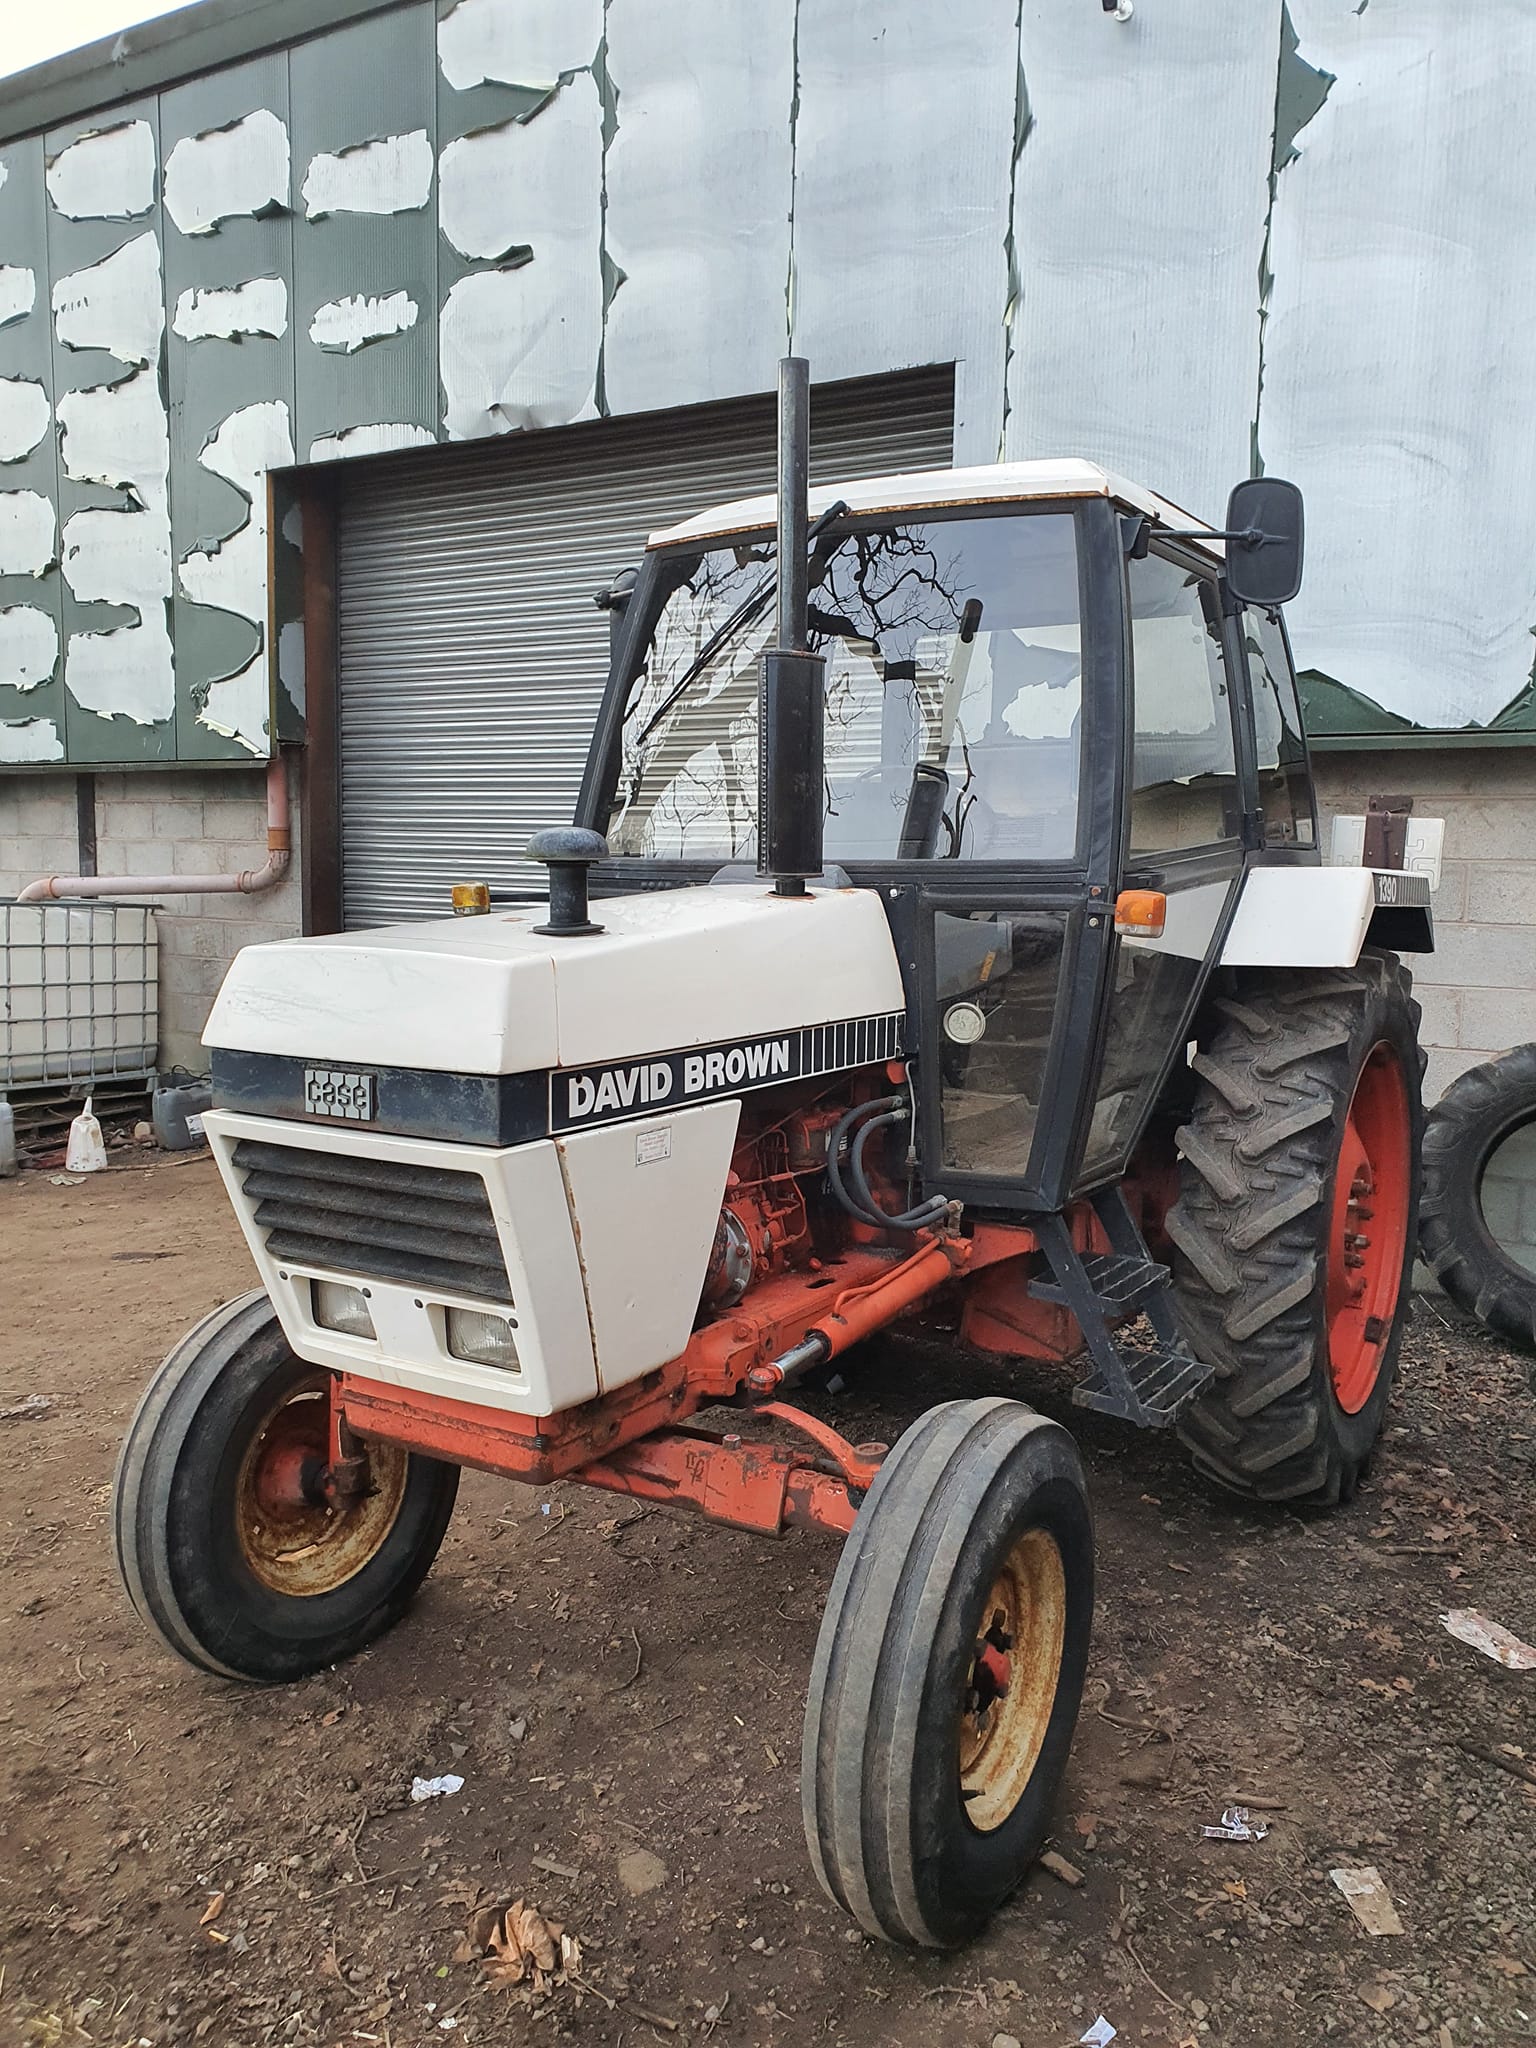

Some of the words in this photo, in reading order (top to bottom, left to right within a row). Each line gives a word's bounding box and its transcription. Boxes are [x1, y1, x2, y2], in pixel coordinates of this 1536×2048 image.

[1378, 876, 1397, 903] 1390
[568, 1062, 673, 1119] DAVID
[684, 1039, 789, 1094] BROWN
